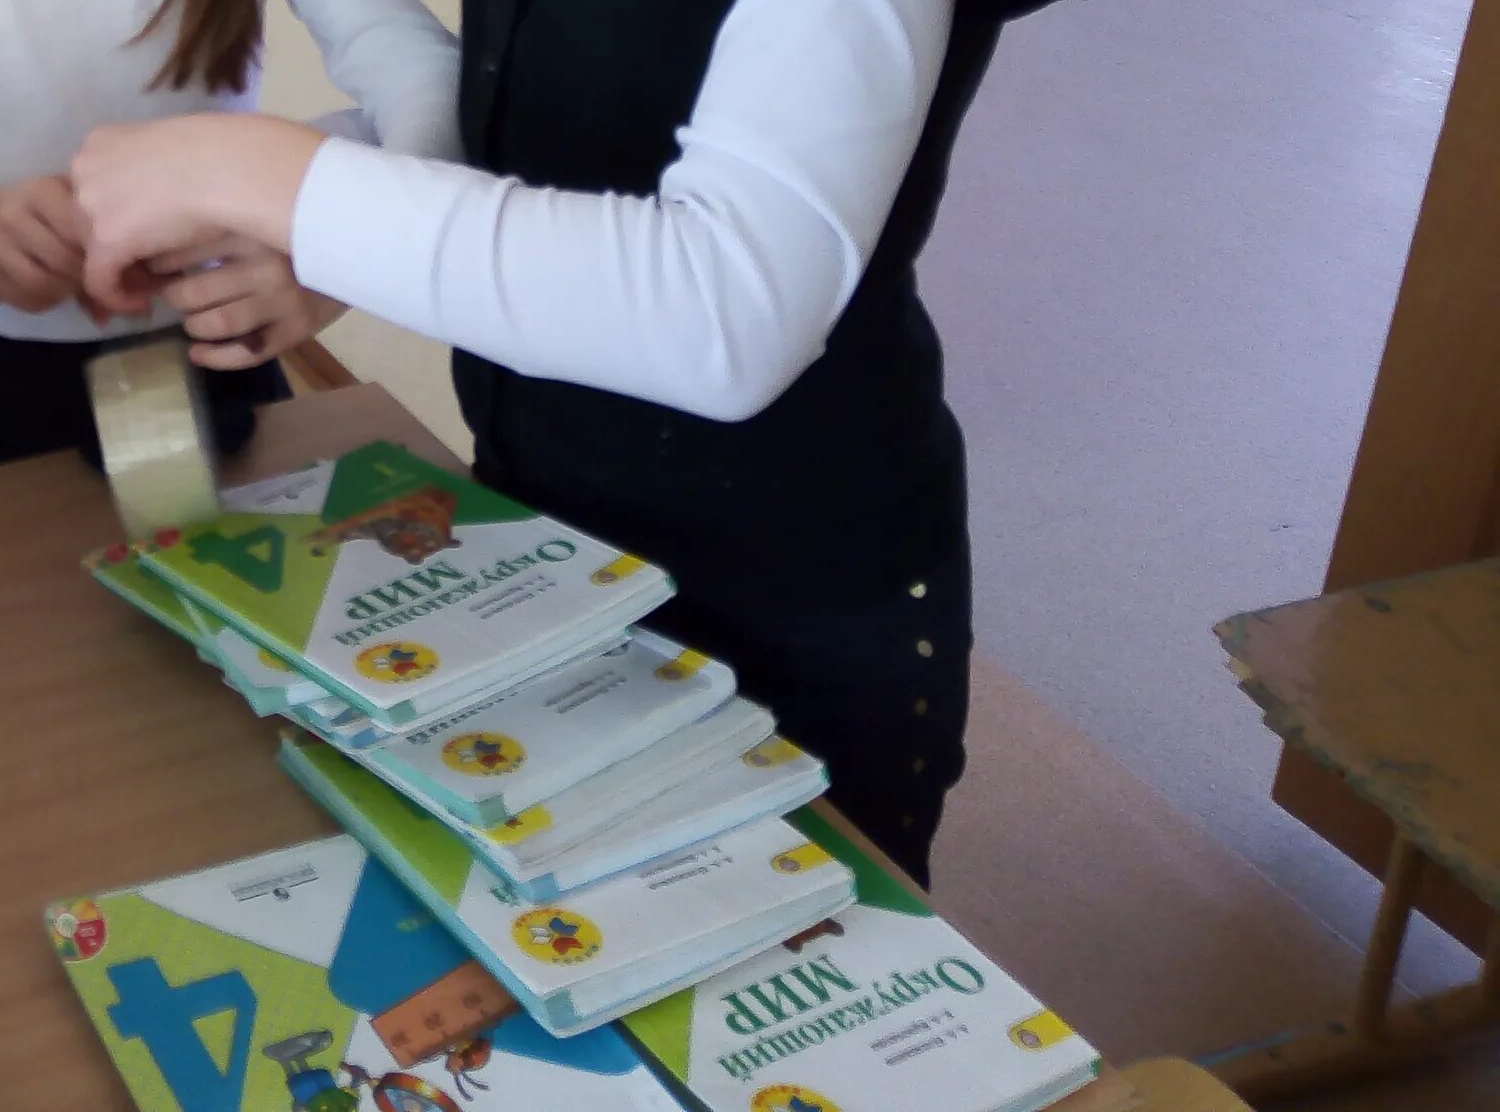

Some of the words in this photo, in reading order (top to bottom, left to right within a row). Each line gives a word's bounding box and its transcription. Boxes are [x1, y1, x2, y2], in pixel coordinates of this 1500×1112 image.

[187, 525, 286, 594] 4
[334, 539, 577, 645] Окружающий
[345, 561, 466, 620] МИР
[106, 956, 258, 1112] 4
[717, 956, 985, 1081] Окружающий
[721, 954, 858, 1035] МИР
